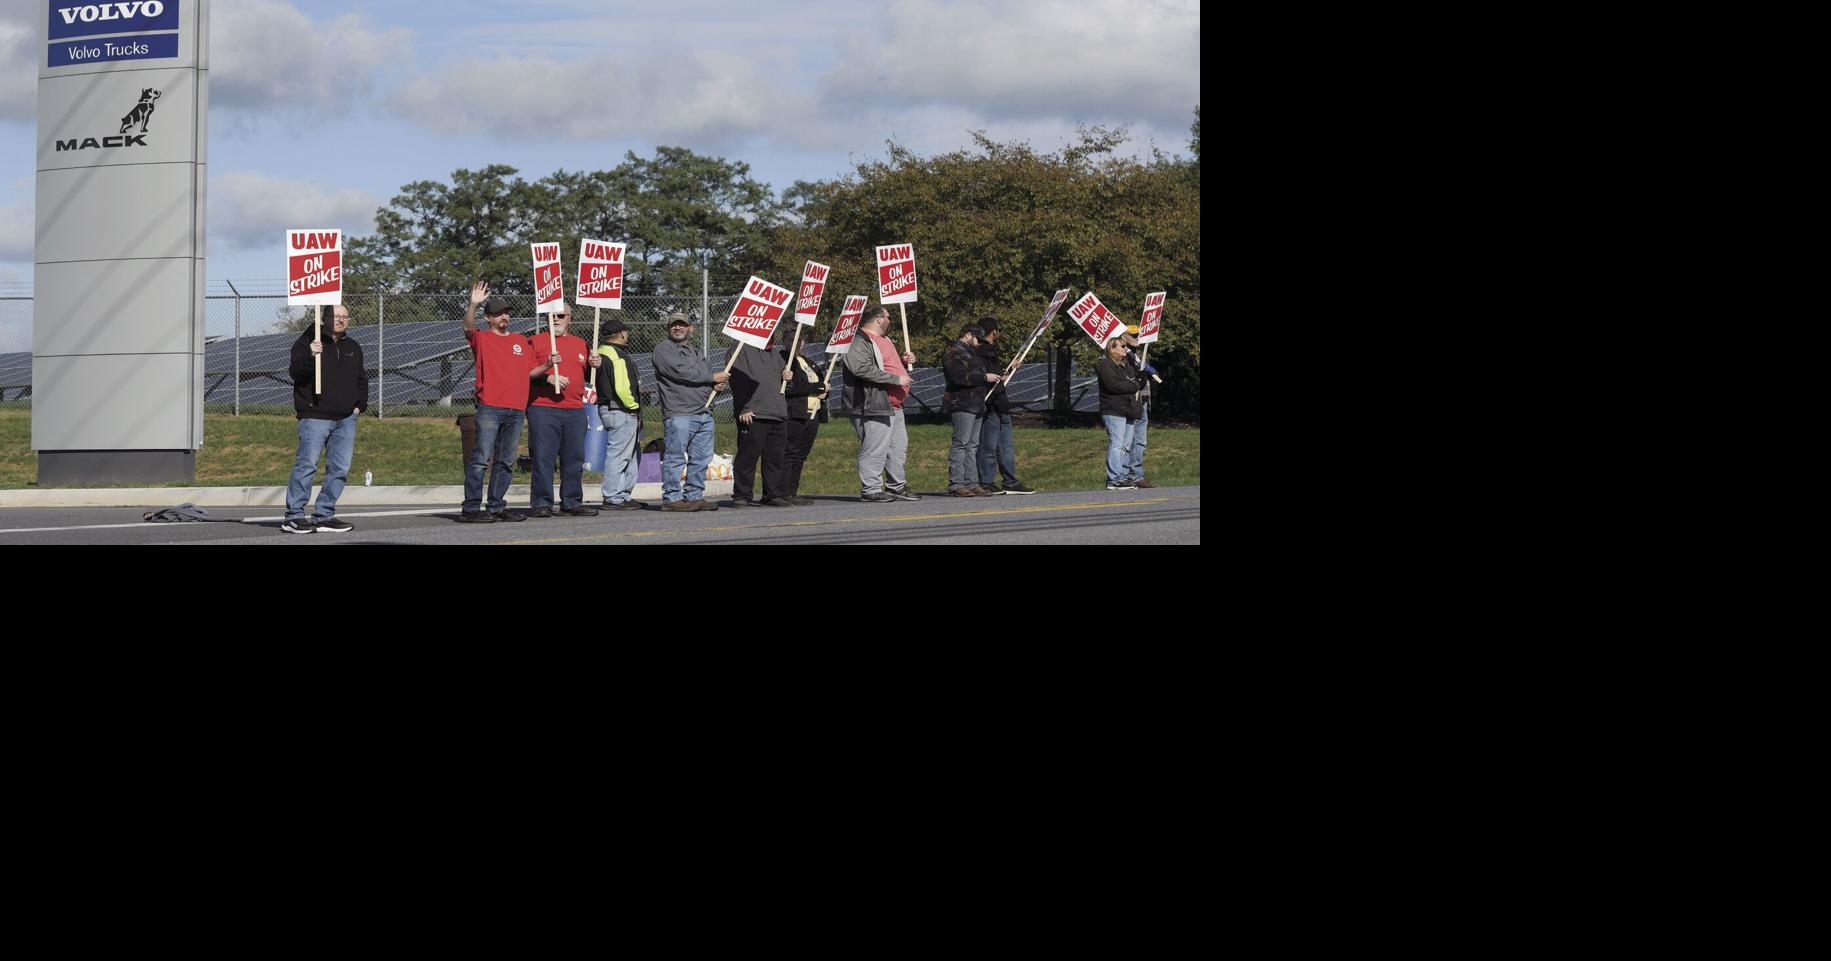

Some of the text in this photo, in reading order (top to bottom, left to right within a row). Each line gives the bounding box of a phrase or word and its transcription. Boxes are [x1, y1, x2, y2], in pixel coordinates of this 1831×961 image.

[58, 0, 164, 24] VOLVO
[68, 41, 149, 60] Volvo Trucks
[56, 134, 148, 152] MACK
[291, 232, 338, 250] UAW
[534, 245, 558, 262] UAW
[584, 242, 623, 262] UAW
[879, 246, 911, 262] UAW
[303, 254, 323, 274] ON
[590, 265, 608, 280] ON
[805, 263, 828, 281] UAW
[889, 263, 903, 280] ON
[290, 266, 340, 295] STRIKE
[543, 266, 552, 284] ON
[881, 271, 915, 296] STRIKE
[538, 275, 561, 303] STRIKE
[579, 276, 622, 297] STRIKE
[748, 280, 790, 306] UAW
[803, 284, 816, 297] ON
[844, 298, 866, 312] UAW
[1071, 295, 1097, 319] UAW
[1146, 294, 1164, 307] UAW
[747, 304, 769, 317] ON
[1088, 311, 1101, 328] ON
[1146, 310, 1157, 323] ON
[728, 315, 777, 330] STRIKE
[841, 316, 855, 330] ON
[1093, 311, 1114, 342] STRIKE
